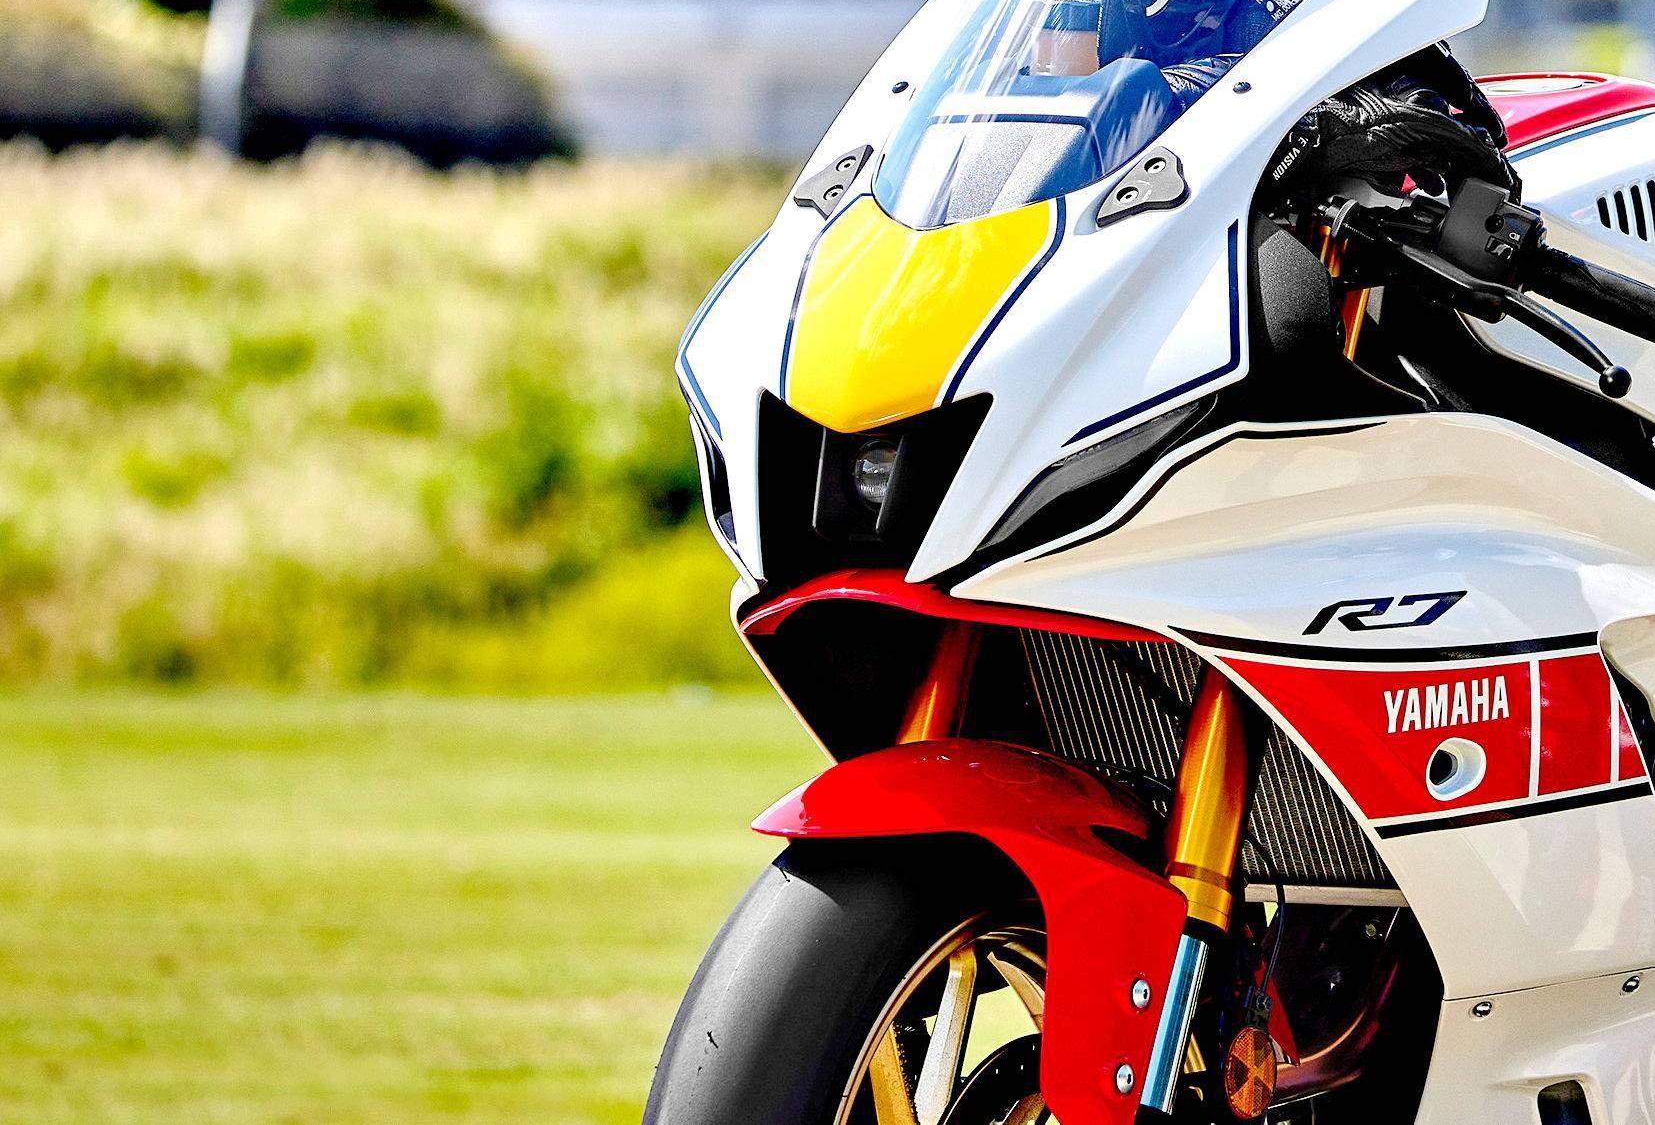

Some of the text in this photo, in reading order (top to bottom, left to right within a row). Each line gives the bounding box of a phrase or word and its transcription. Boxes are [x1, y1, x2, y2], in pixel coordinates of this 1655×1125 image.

[1272, 146, 1301, 181] VISION
[1302, 590, 1468, 635] R7
[1383, 675, 1511, 734] YAMAHA
